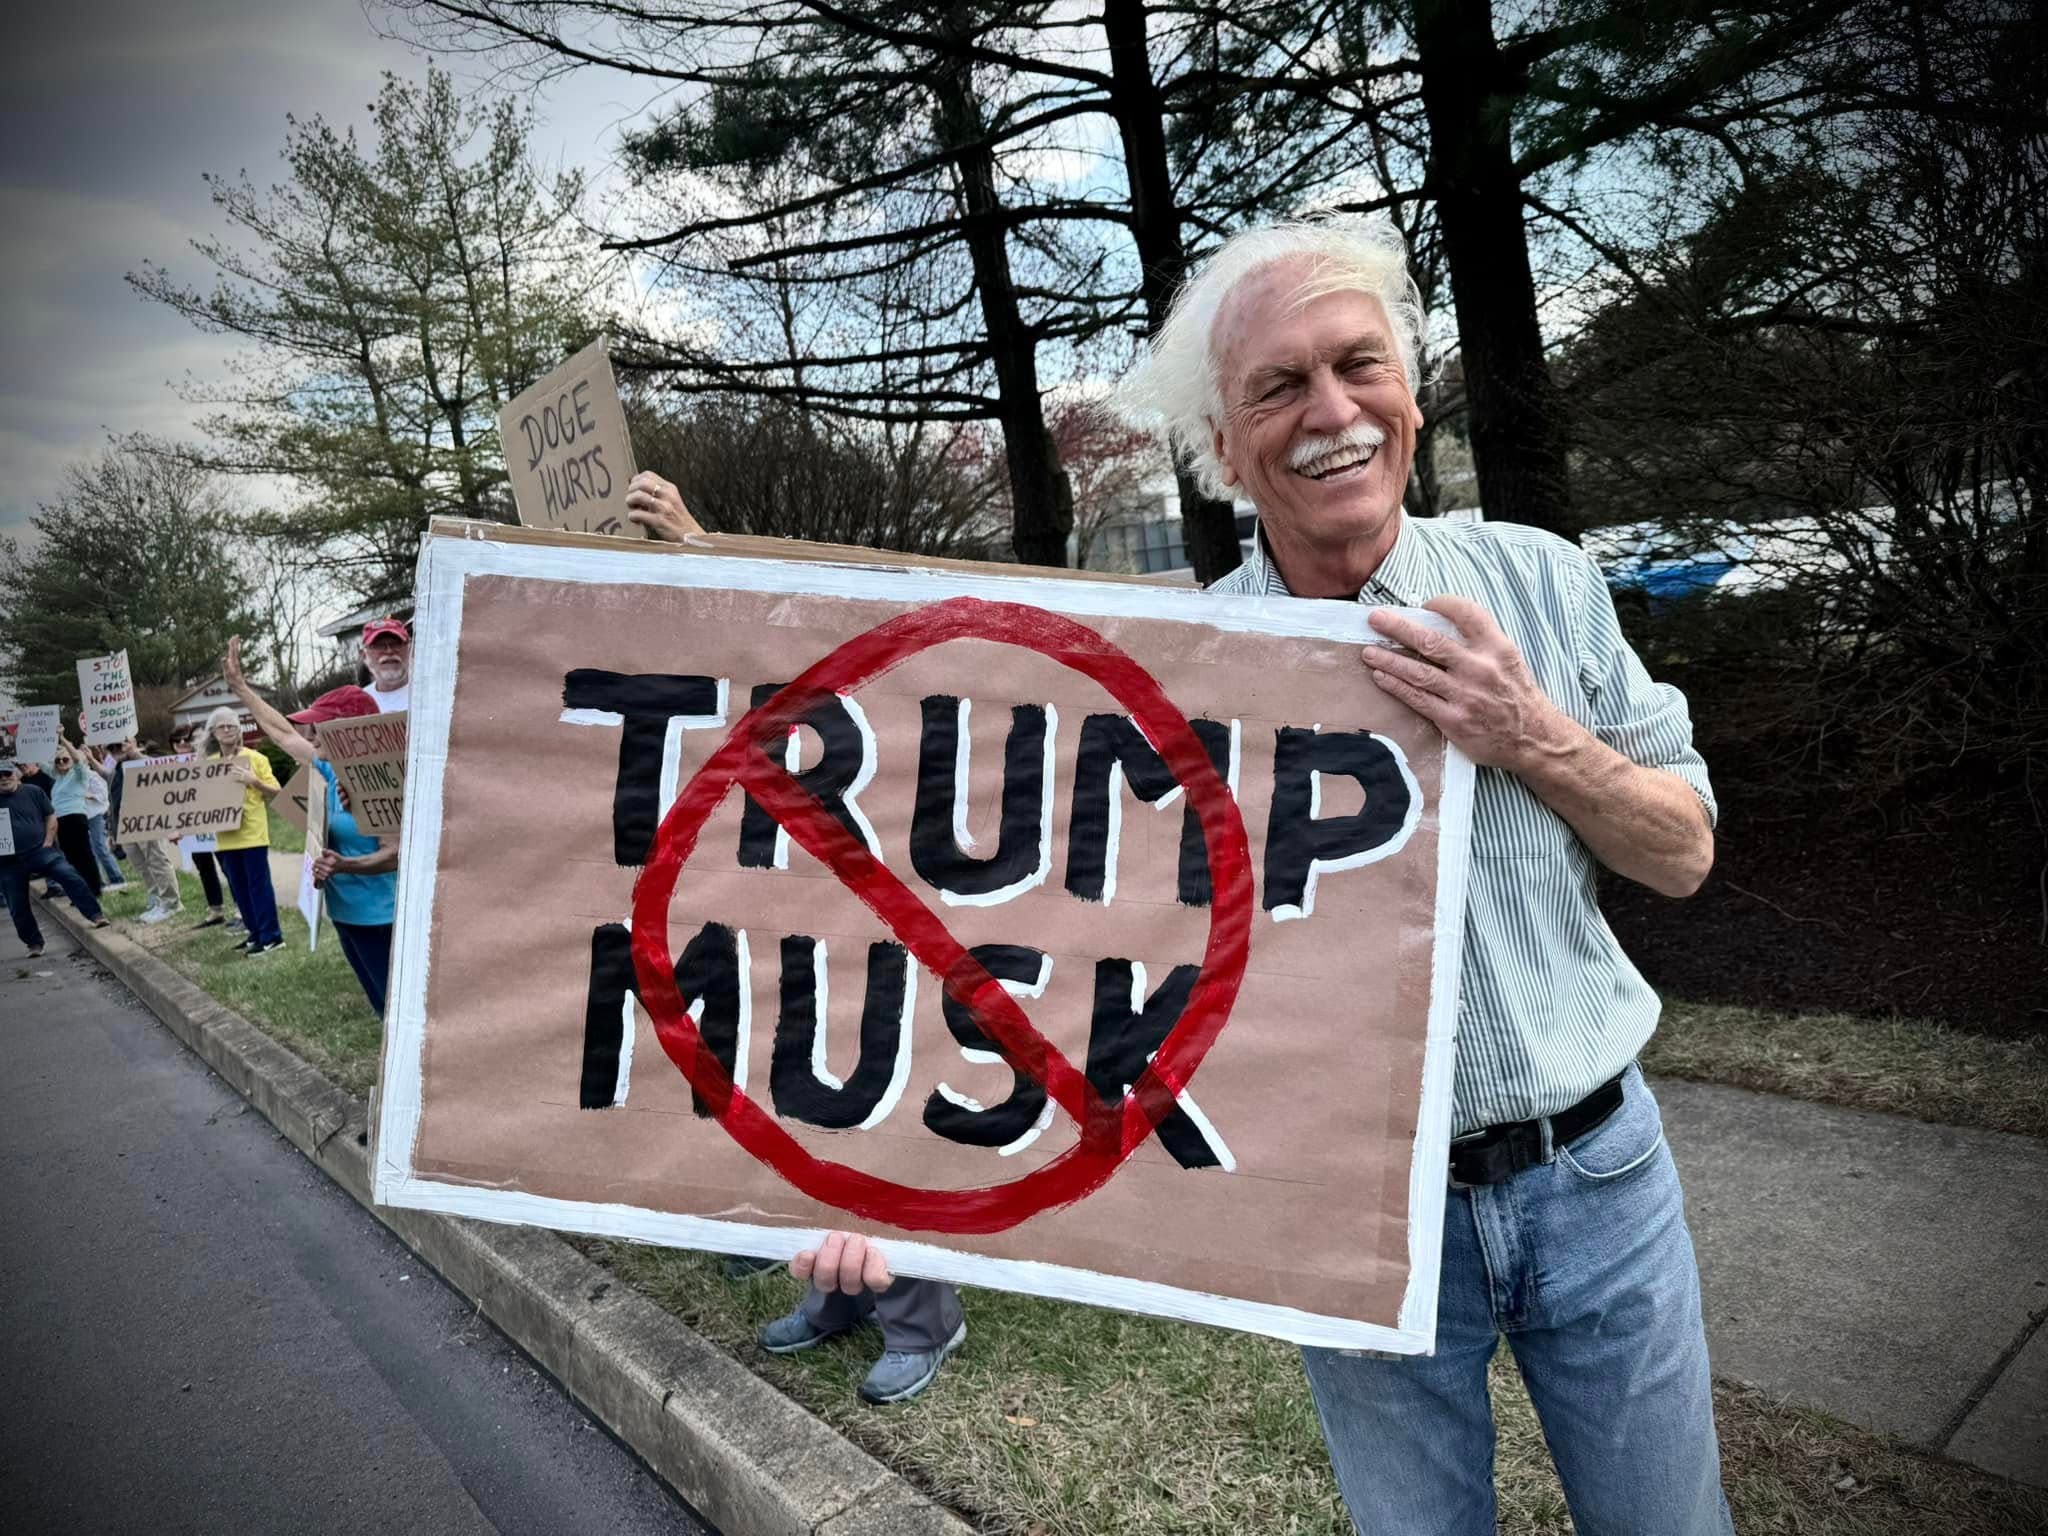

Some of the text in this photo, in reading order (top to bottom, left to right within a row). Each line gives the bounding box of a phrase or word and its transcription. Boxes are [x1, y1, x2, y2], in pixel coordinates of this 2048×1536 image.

[520, 379, 595, 472] DOGE
[539, 444, 611, 521] HURTS
[136, 763, 234, 788] HANDS OFF
[163, 788, 197, 805] OUR
[344, 761, 400, 793] FIRING
[560, 667, 1425, 922] TRUMP
[121, 806, 242, 834] SOCIAL SECURITY
[580, 918, 1237, 1172] MUSK
